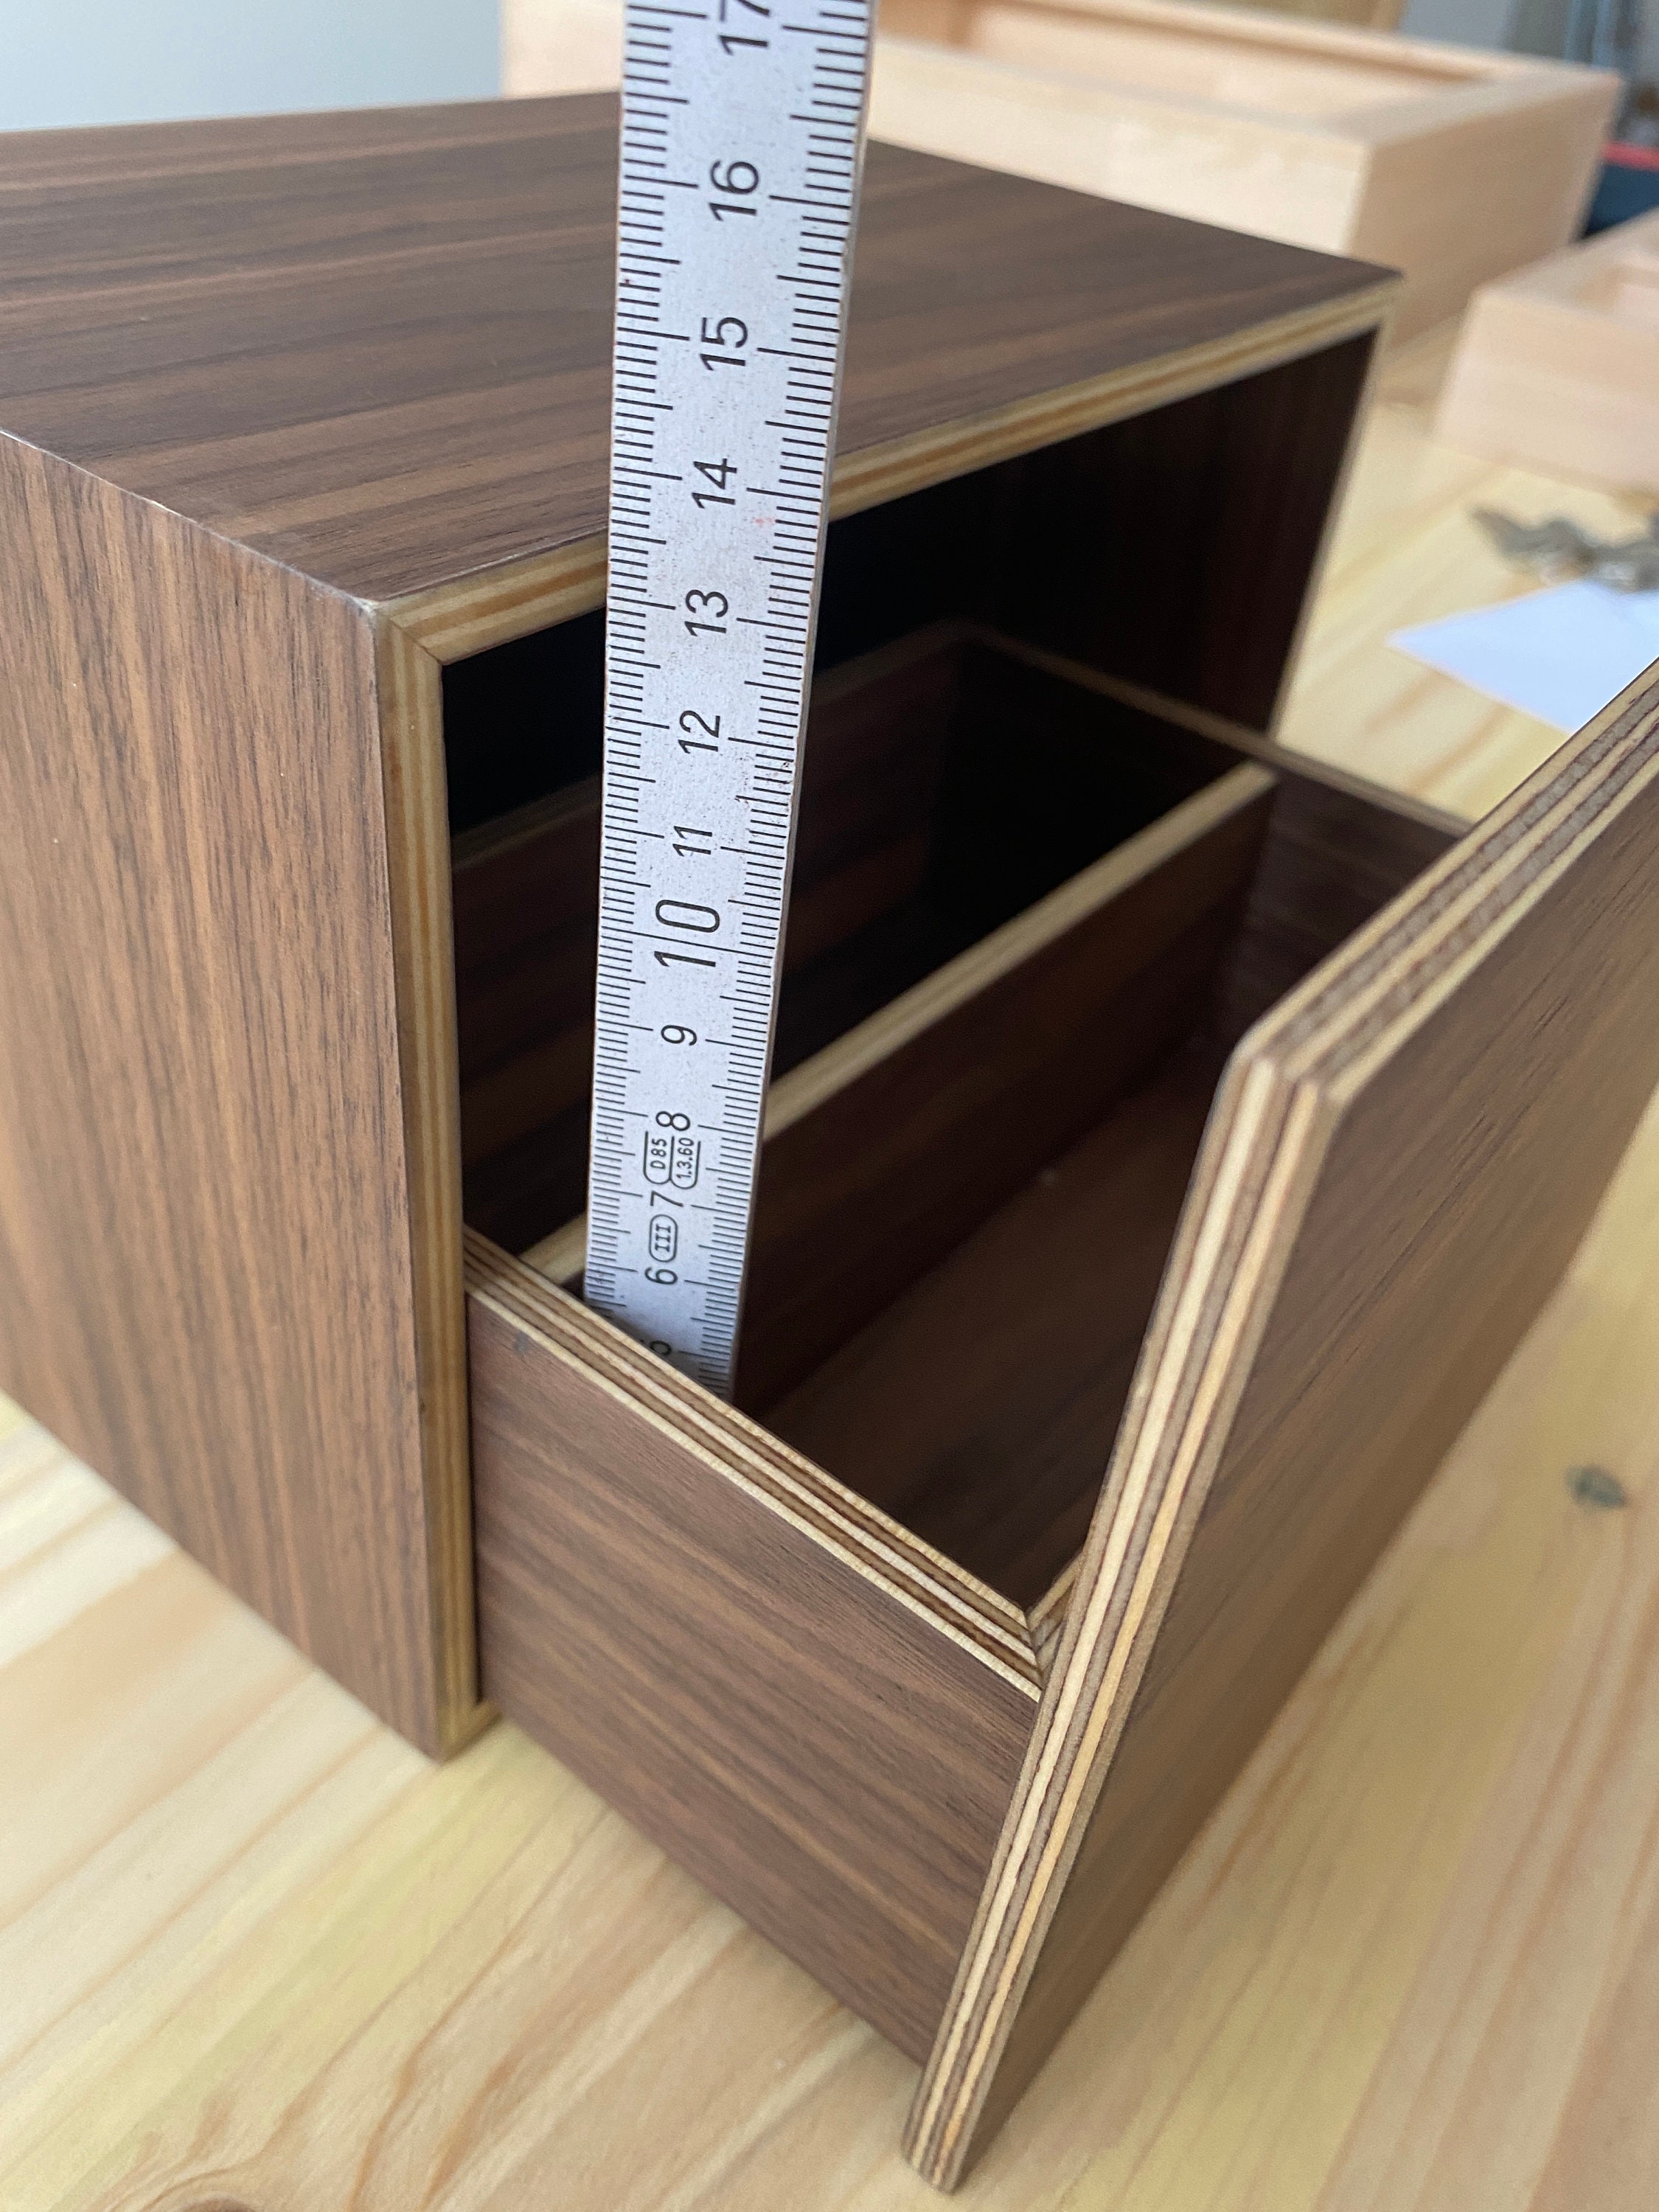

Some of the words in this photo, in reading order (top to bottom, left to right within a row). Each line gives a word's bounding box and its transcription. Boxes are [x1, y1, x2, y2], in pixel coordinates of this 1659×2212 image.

[709, 160, 759, 220] 16
[699, 316, 748, 370] 15
[691, 458, 737, 508] 14
[684, 589, 728, 636] 13
[678, 710, 720, 754] 12
[672, 825, 713, 857] 11
[654, 900, 720, 967] 10
[661, 1024, 698, 1046] 9
[655, 1110, 691, 1131] 8
[676, 1137, 695, 1179] 1.3.60
[650, 1190, 684, 1207] 7
[655, 1223, 671, 1252] III
[644, 1267, 678, 1284] 6
